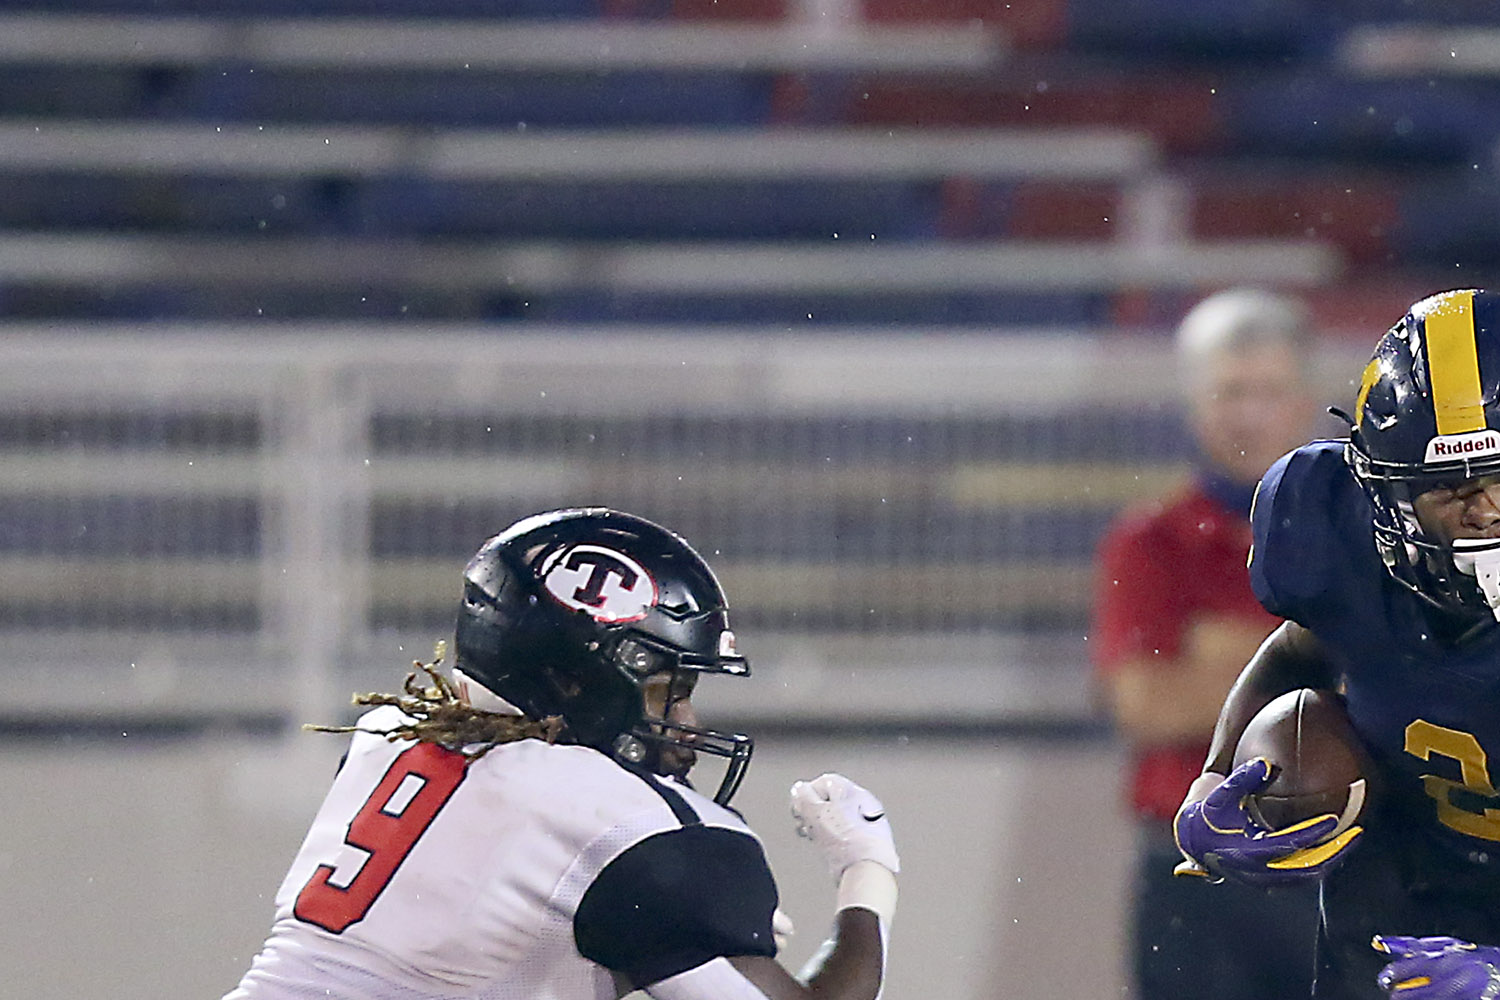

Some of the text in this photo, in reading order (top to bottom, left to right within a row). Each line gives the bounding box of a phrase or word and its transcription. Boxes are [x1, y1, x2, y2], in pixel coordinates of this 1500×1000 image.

[1434, 436, 1497, 456] Riddell
[564, 551, 639, 609] T
[293, 740, 469, 935] 9
